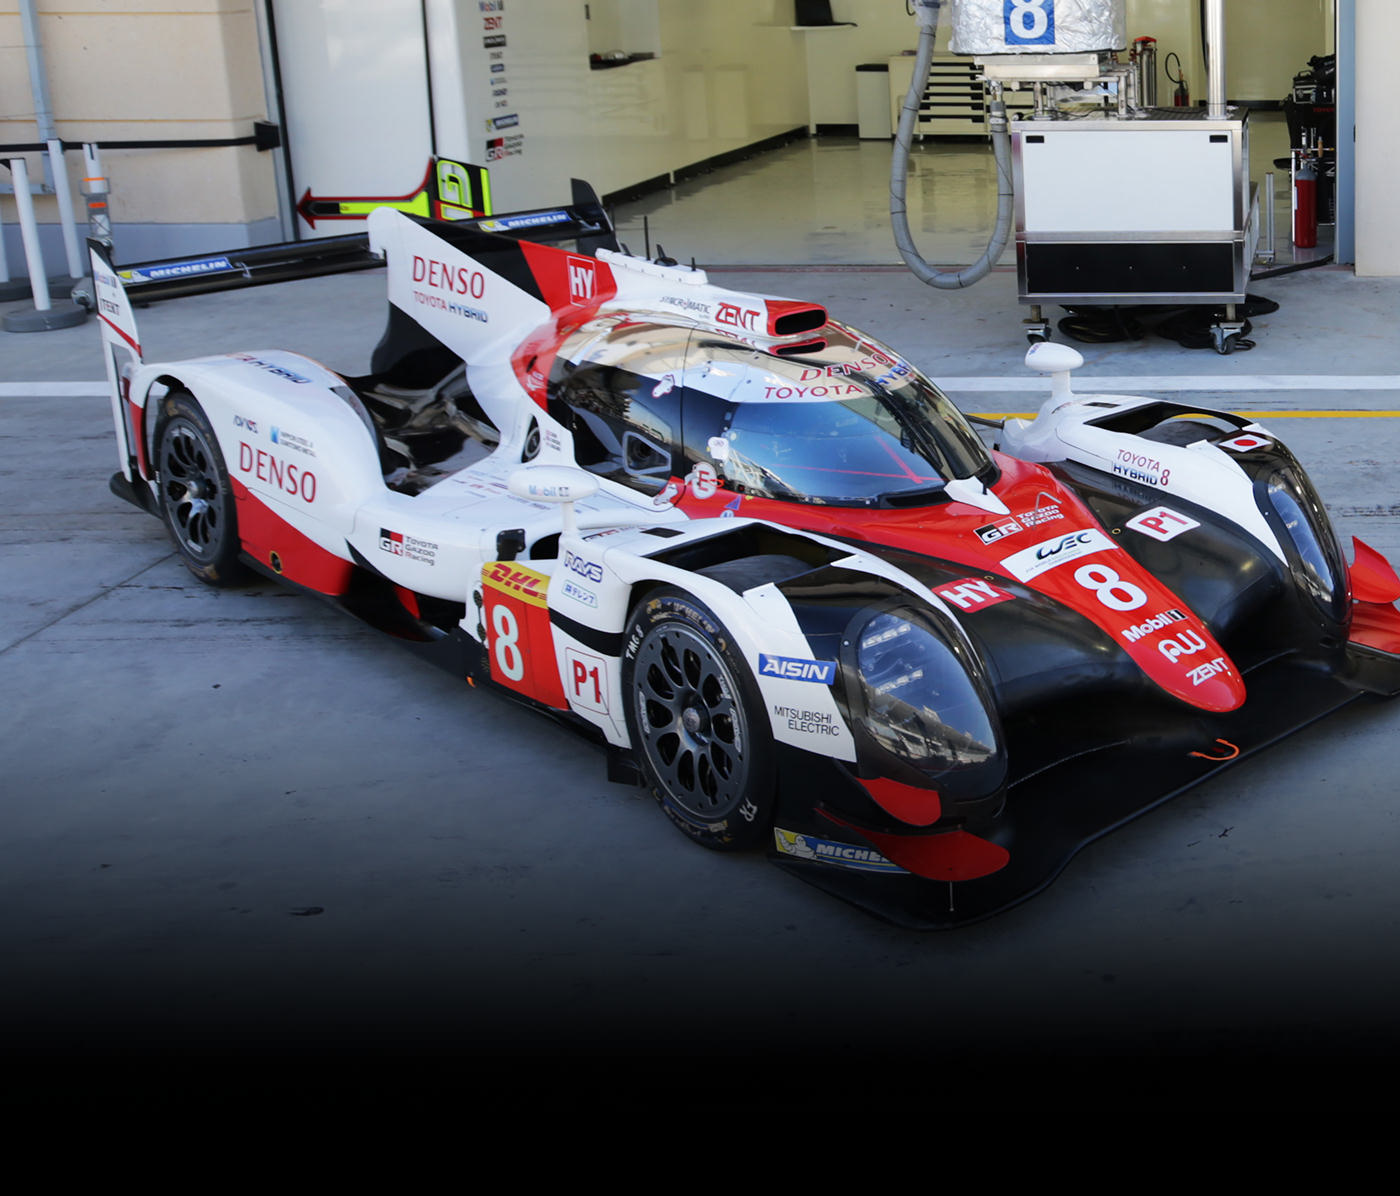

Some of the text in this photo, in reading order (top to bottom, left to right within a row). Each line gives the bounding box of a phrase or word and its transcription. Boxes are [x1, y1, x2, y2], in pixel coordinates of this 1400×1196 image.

[1008, 0, 1048, 39] 8
[508, 213, 567, 228] MICHELIN
[150, 259, 227, 278] MICHELIN
[413, 255, 485, 299] DENSO
[568, 265, 594, 299] HY
[414, 291, 488, 323] TOYOTA HYBRID
[714, 302, 761, 332] ZENT
[800, 353, 889, 381] DENSO
[764, 384, 863, 399] TOYOTA
[239, 440, 317, 503] DENSO
[1117, 449, 1161, 473] TOYOTA
[1113, 462, 1171, 486] HYBRID 8
[528, 484, 556, 497] Mobil
[1016, 504, 1060, 519] TOYOTA
[1020, 509, 1060, 523] GAZOO
[1025, 513, 1065, 528] Racing
[1138, 511, 1189, 535] P1
[405, 535, 439, 550] TOYOTA
[981, 522, 1020, 544] GR
[380, 537, 403, 556] GR
[405, 551, 435, 566] Racing
[1036, 532, 1092, 561] WEC
[564, 549, 603, 584] RAYS
[489, 563, 541, 597] DHL
[1074, 563, 1148, 612] 8
[940, 580, 1000, 609] HY
[1121, 613, 1171, 643] Mobil
[493, 604, 525, 682] 8
[573, 659, 601, 704] P1
[762, 659, 830, 681] AISIN
[1186, 656, 1229, 687] ZENT
[774, 705, 832, 724] MITSUBISHI
[788, 719, 840, 736] ELECTRIC
